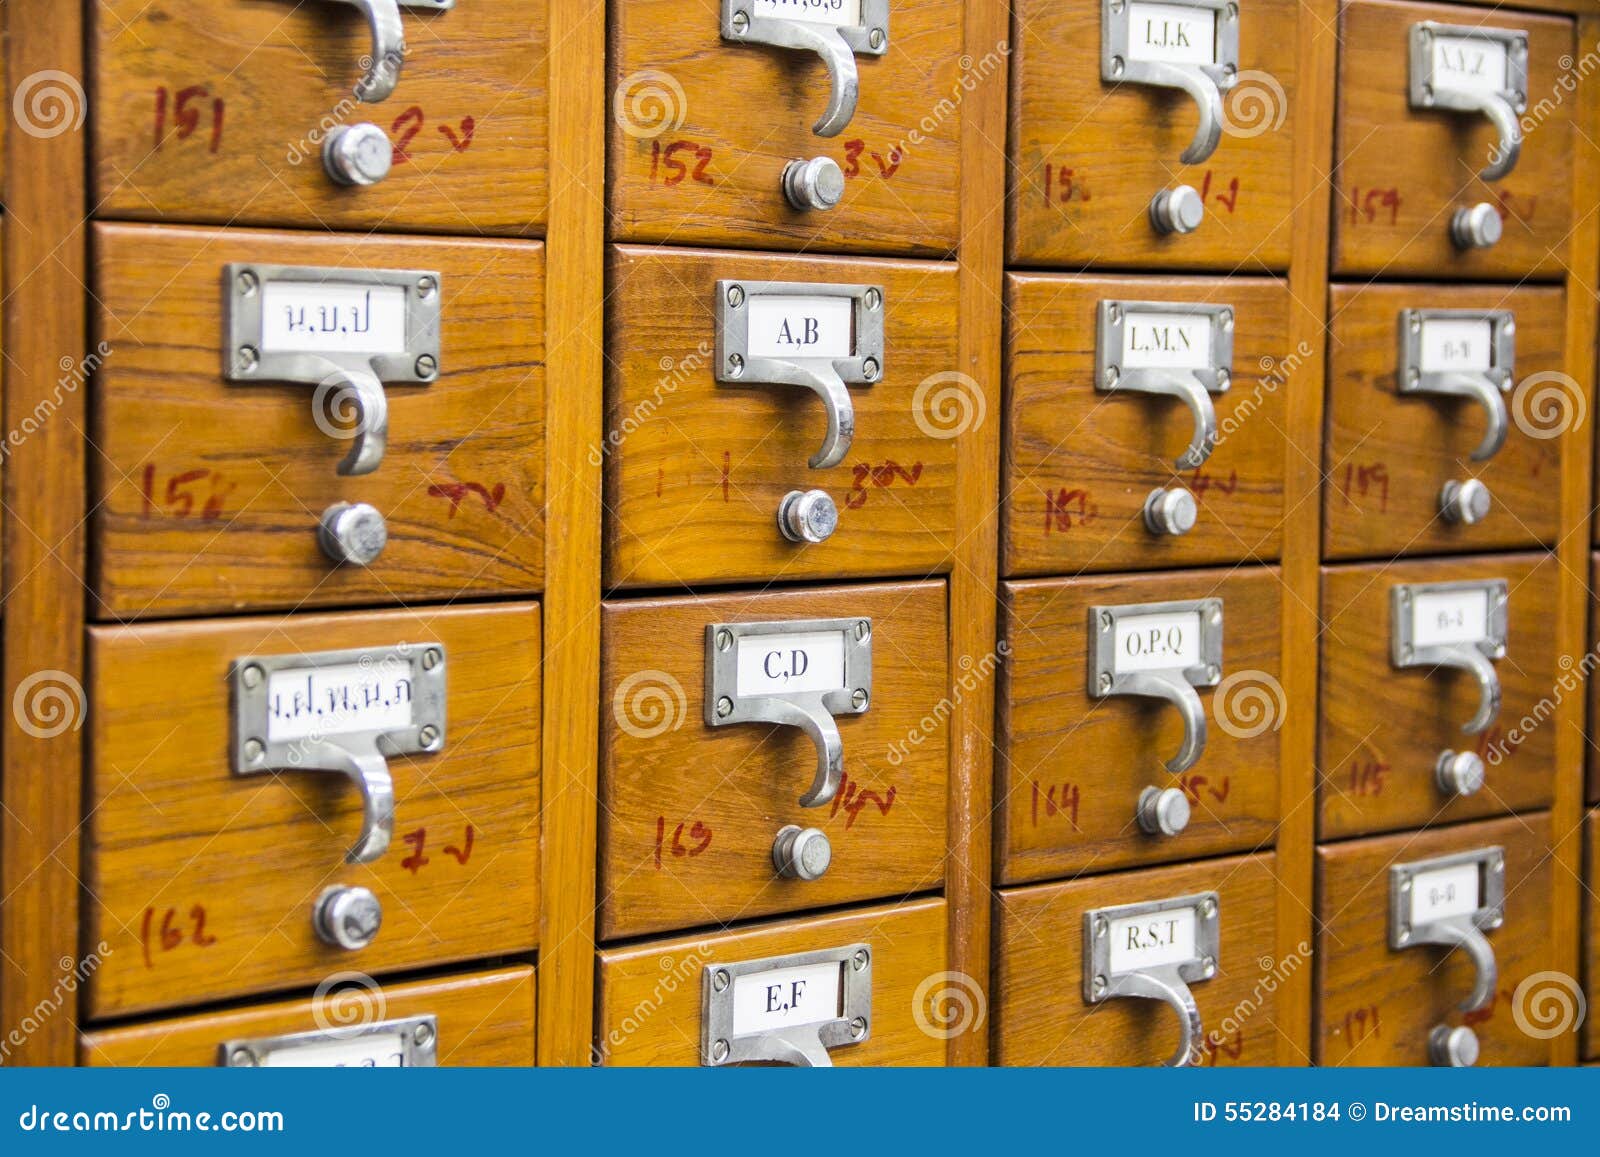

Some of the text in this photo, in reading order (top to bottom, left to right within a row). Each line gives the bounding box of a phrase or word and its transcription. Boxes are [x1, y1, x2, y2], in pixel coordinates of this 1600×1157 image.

[154, 85, 225, 154] 151
[649, 139, 714, 187] 152
[776, 317, 820, 348] A,B
[763, 648, 809, 681] C,D
[140, 904, 217, 969] 162
[764, 979, 807, 1016] E,F
